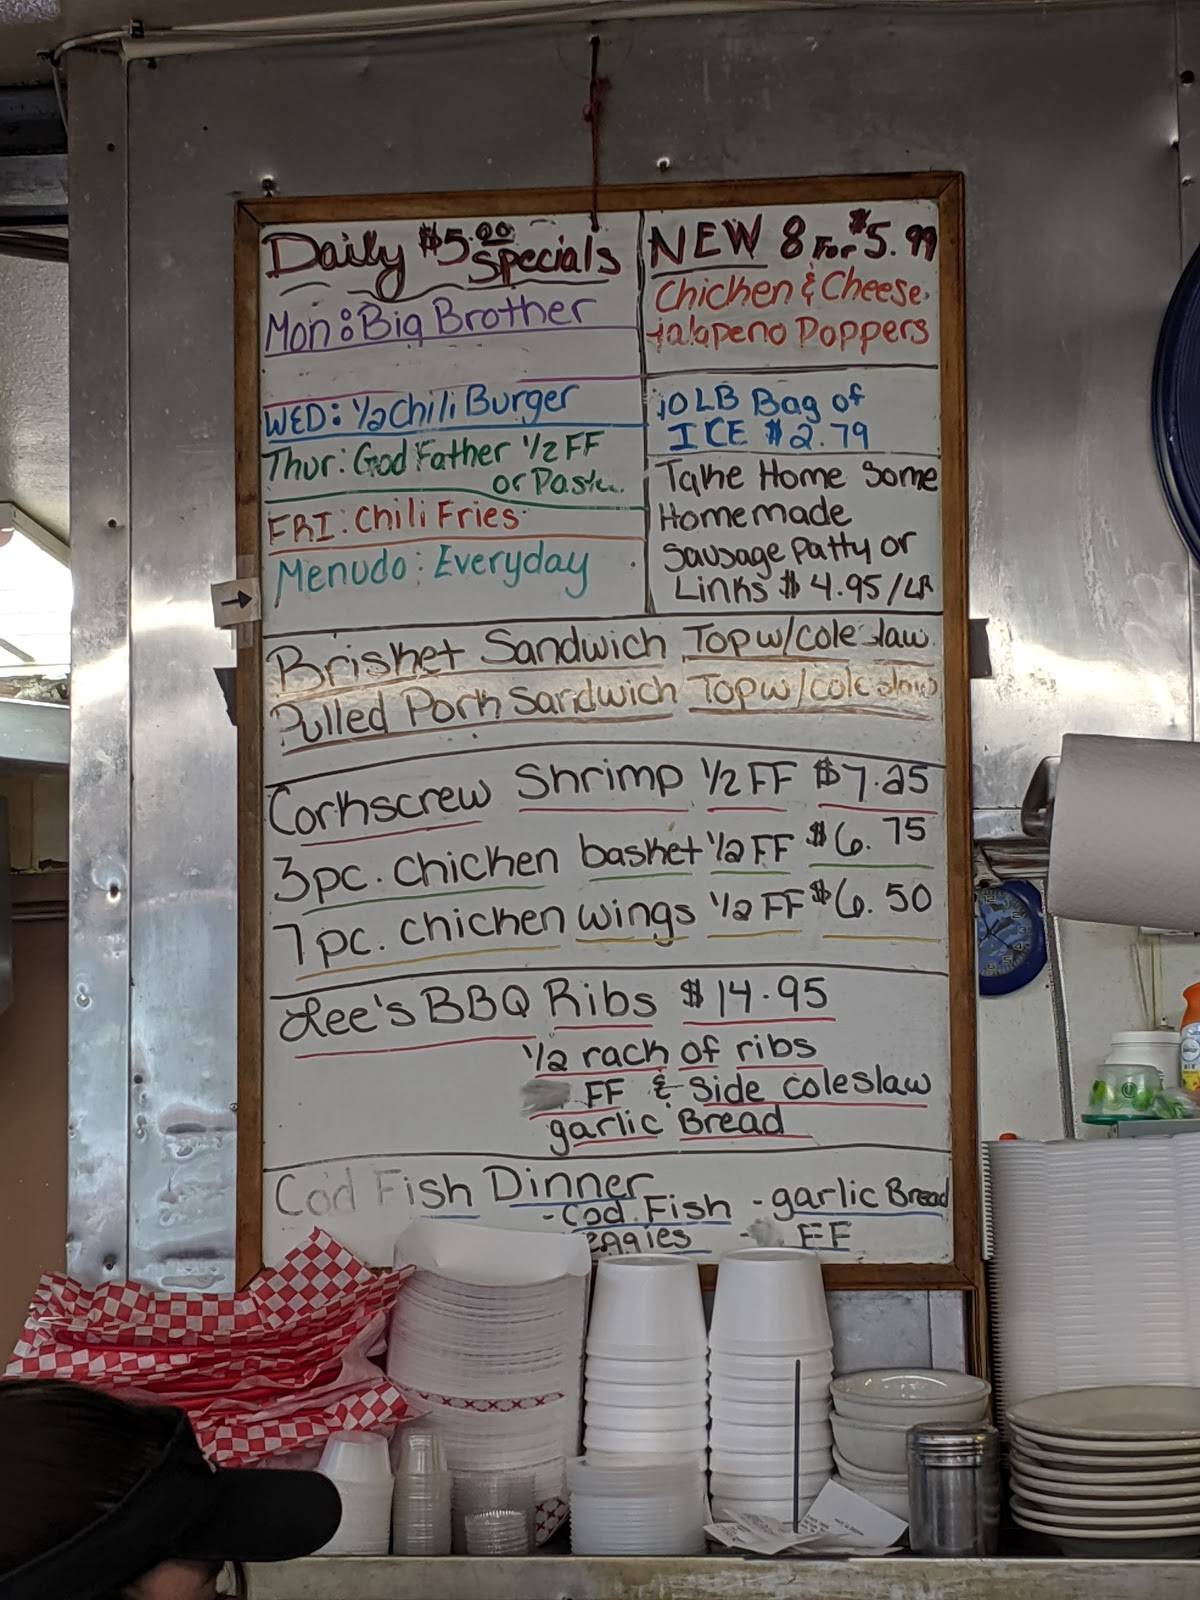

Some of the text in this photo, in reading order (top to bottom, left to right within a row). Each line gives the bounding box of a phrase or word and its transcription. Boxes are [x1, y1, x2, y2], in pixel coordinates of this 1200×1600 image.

[648, 213, 763, 269] NEW
[780, 215, 806, 260] 8
[849, 208, 938, 262] $5.99
[262, 231, 406, 302] Daily
[431, 294, 597, 335] Brother
[655, 274, 793, 314] Chicken
[795, 316, 930, 355] Poppers
[263, 402, 342, 437] WED:
[465, 383, 580, 425] Burger
[695, 384, 740, 412] LB
[751, 387, 822, 424] Bag
[832, 383, 866, 413] of
[261, 445, 346, 482] Thur:
[352, 437, 408, 476] God
[414, 439, 512, 473] Father
[566, 431, 605, 461] FF
[667, 416, 870, 451] ICE $2.79
[492, 472, 527, 495] or
[655, 458, 744, 497] Take
[759, 458, 849, 492] Home
[880, 531, 917, 557] or
[433, 540, 589, 599] Everyday
[675, 574, 769, 604] Links
[266, 638, 466, 693] Brisket
[481, 624, 667, 665] Sandwich
[683, 622, 751, 657] Top
[270, 690, 390, 747] Pulled
[399, 685, 501, 727] Pork
[686, 673, 757, 710] Top
[268, 779, 492, 836] Corkscrew
[747, 761, 798, 796] FF
[815, 755, 930, 802] $7.25
[579, 832, 704, 869] basket
[750, 833, 795, 865] FF
[805, 817, 927, 857] $6.75
[577, 899, 697, 948] wings
[760, 888, 805, 921] FF
[808, 877, 933, 919] $6.50
[279, 974, 828, 1043] Lee's BBQ Ribs $14.95
[582, 1038, 669, 1069] rack
[680, 1034, 721, 1066] of
[736, 1033, 818, 1062] ribs
[585, 1078, 625, 1109] FF
[548, 1104, 785, 1157] garlic Bread
[275, 1164, 655, 1217] Cod Fish Dinner
[642, 1193, 732, 1224] Fish
[884, 1177, 950, 1209] Bread
[797, 1221, 853, 1250] FF
